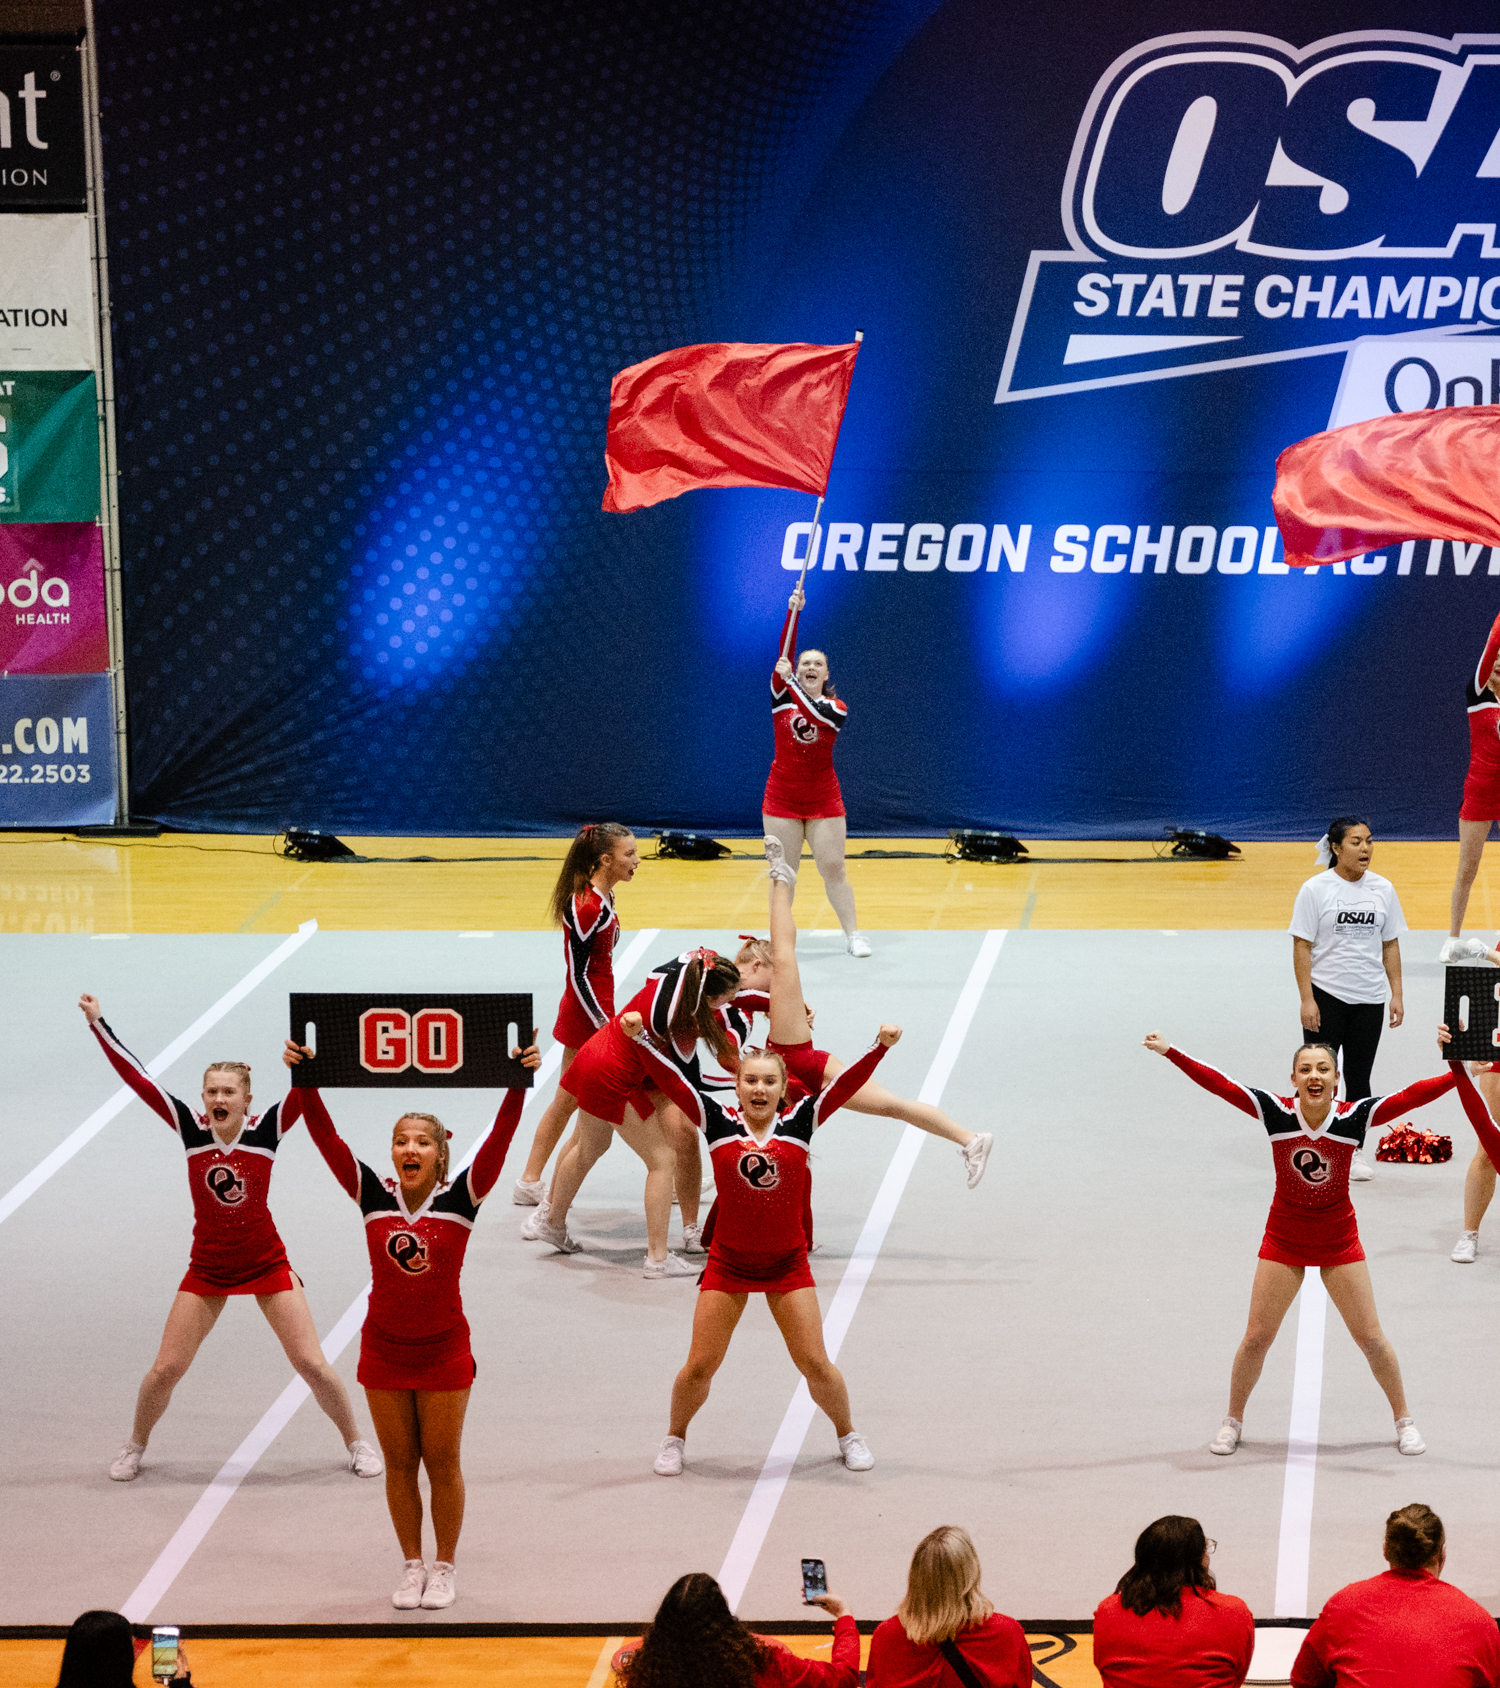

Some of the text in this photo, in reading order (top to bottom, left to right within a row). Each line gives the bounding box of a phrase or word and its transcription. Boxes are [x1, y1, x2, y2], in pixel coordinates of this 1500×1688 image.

[1073, 274, 1244, 317] STATE
[780, 521, 1032, 573] OREGON
[1049, 524, 1290, 576] SCHOOL
[15, 612, 70, 625] HEALTH
[2, 717, 89, 754] .COM
[0, 764, 91, 784] 22.2503
[1337, 911, 1375, 925] OSAA
[359, 1007, 464, 1074] GO
[205, 1163, 247, 1207] OC
[737, 1150, 781, 1191] OC
[1292, 1147, 1333, 1187] OC
[385, 1230, 430, 1275] OC
